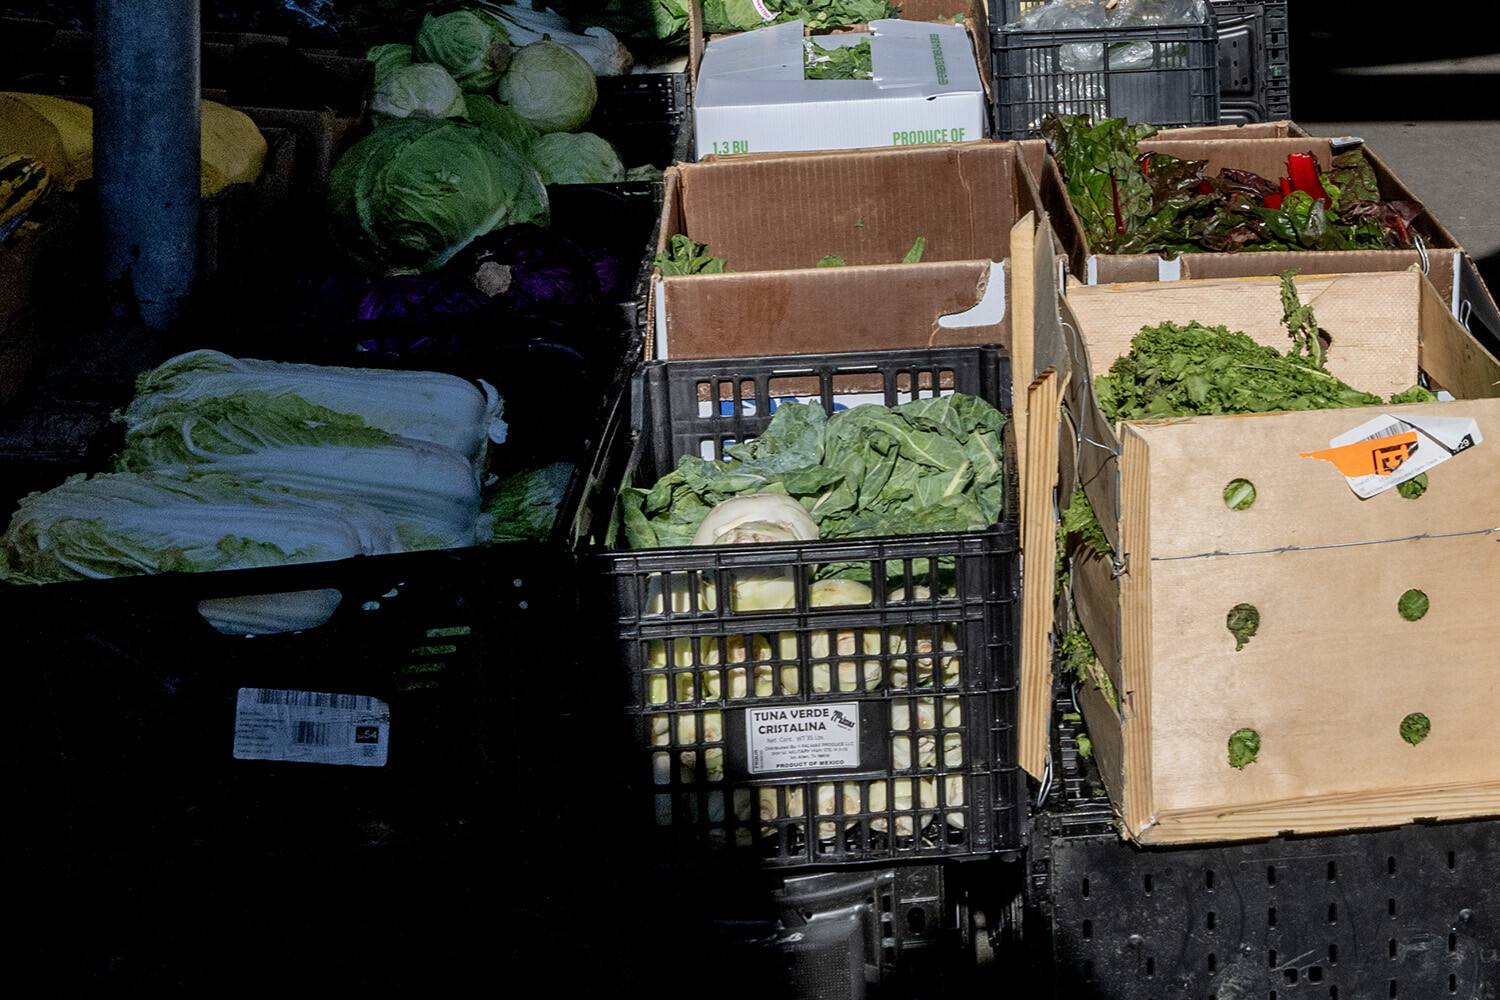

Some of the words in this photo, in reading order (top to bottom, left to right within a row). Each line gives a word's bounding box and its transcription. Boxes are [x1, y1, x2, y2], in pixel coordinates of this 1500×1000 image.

[893, 129, 948, 147] PRODUCE
[950, 127, 965, 143] OF
[713, 141, 730, 155] 1.3
[732, 140, 749, 154] BU
[754, 711, 787, 721] TUNA
[790, 708, 829, 719] VERDE
[758, 722, 827, 735] CRISTALINA
[776, 761, 807, 769] PRODUCT
